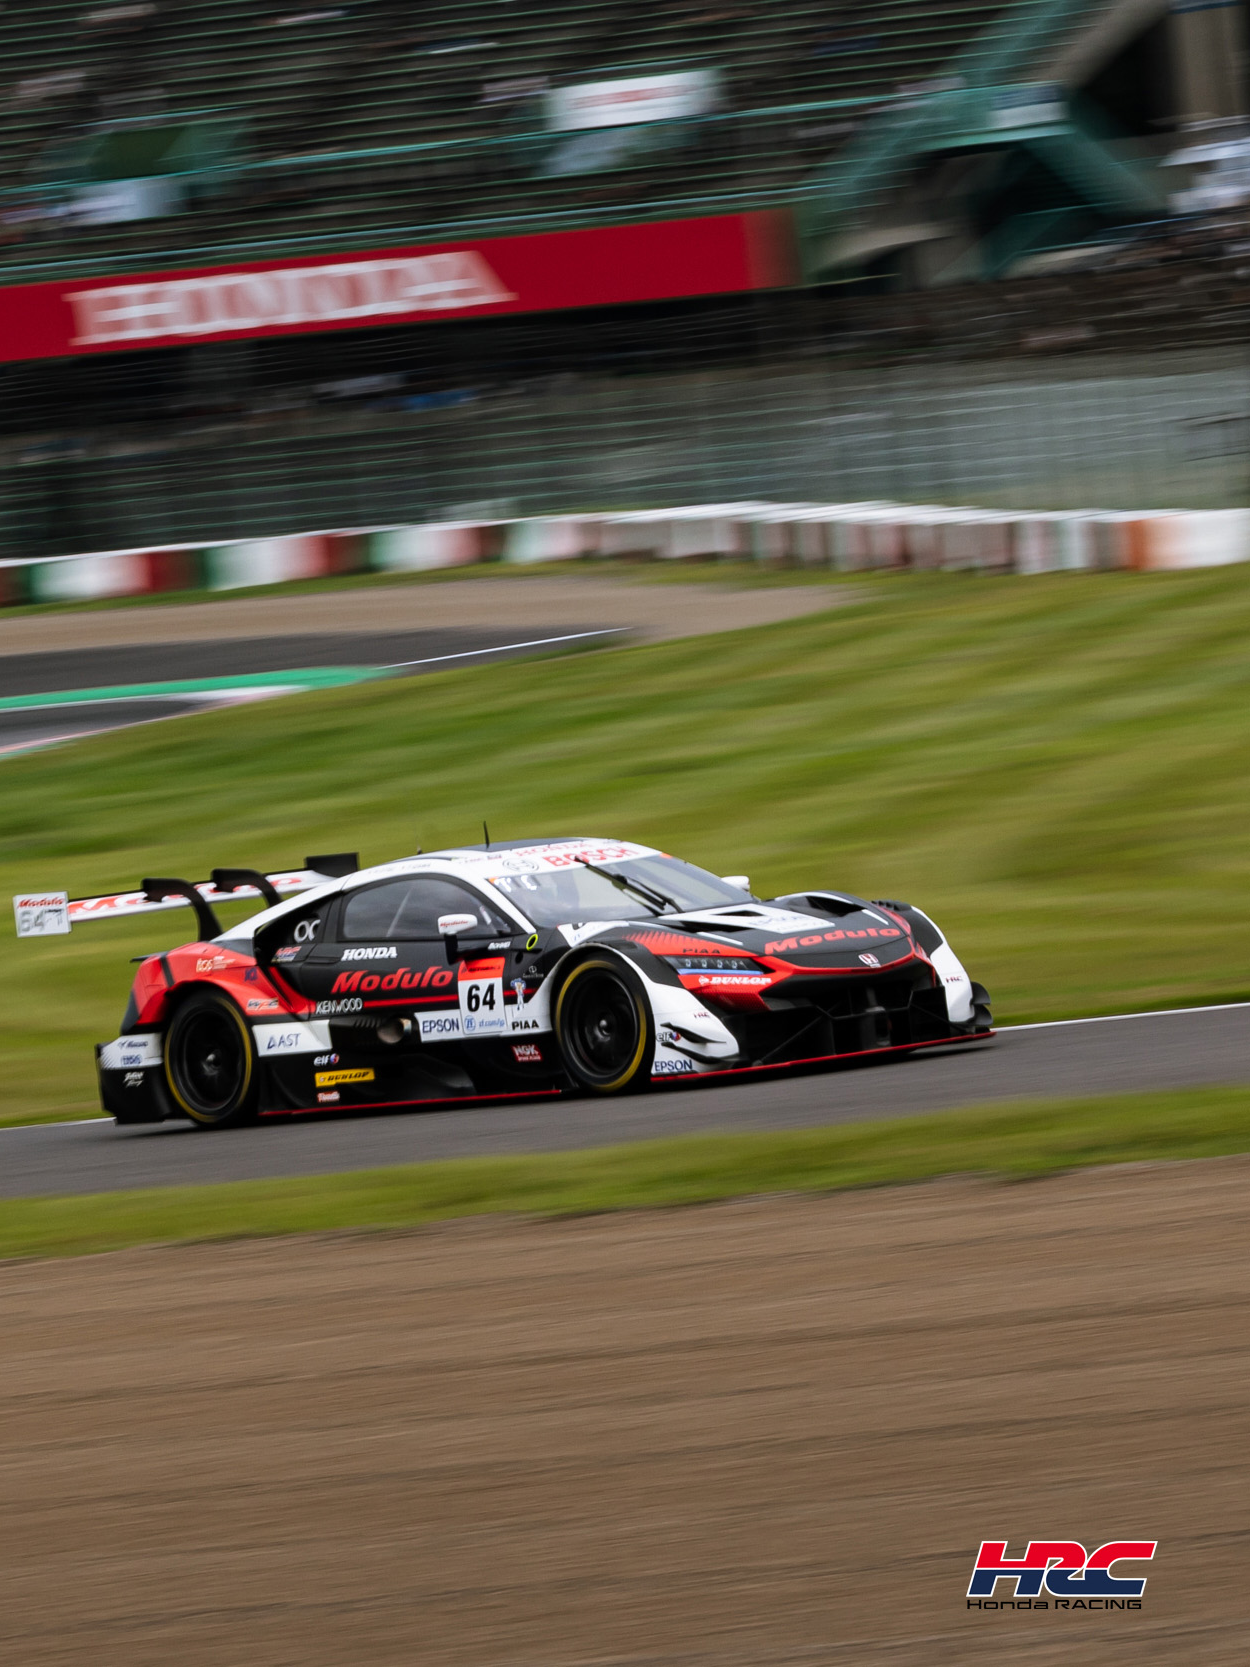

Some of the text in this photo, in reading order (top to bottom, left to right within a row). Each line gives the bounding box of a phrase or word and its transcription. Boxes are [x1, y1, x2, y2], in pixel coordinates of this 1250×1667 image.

[61, 249, 519, 347] HONDA
[542, 847, 639, 867] BOSCH
[764, 927, 901, 955] Modulo
[341, 946, 398, 962] HONDA
[330, 965, 454, 995] Modulo
[709, 976, 772, 986] DUNLOP
[466, 982, 496, 1012] 64
[315, 998, 363, 1015] KENWOOD
[422, 1018, 460, 1033] EPSON
[512, 1019, 539, 1031] PIAA
[656, 1031, 672, 1042] elf
[513, 1044, 539, 1057] NGK
[313, 1055, 330, 1067] elf
[654, 1059, 693, 1072] EPSON
